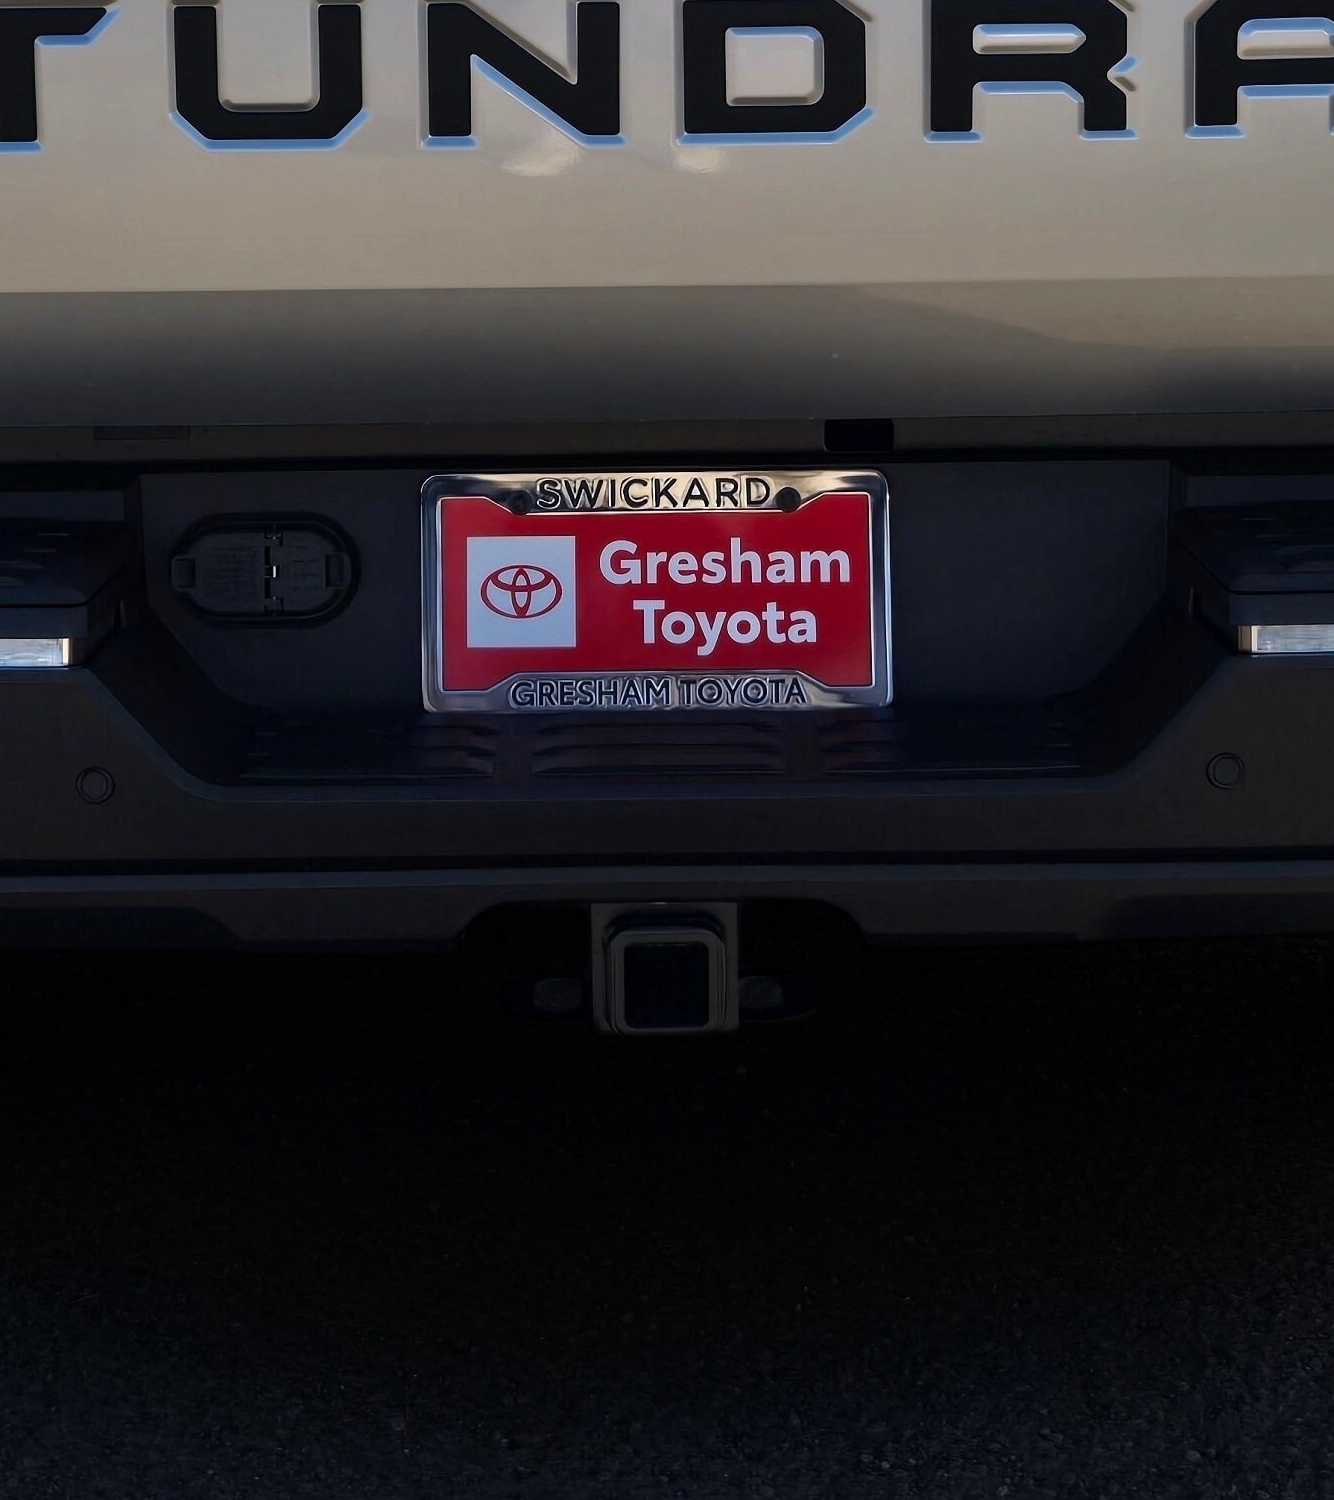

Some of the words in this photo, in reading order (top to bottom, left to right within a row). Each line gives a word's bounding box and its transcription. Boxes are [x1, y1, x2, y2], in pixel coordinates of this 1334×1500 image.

[536, 476, 771, 509] SWICKARD
[599, 538, 850, 584] Gresham
[632, 600, 817, 655] Toyota
[510, 678, 670, 707] GRESHAM
[680, 678, 807, 706] TOYOTA
